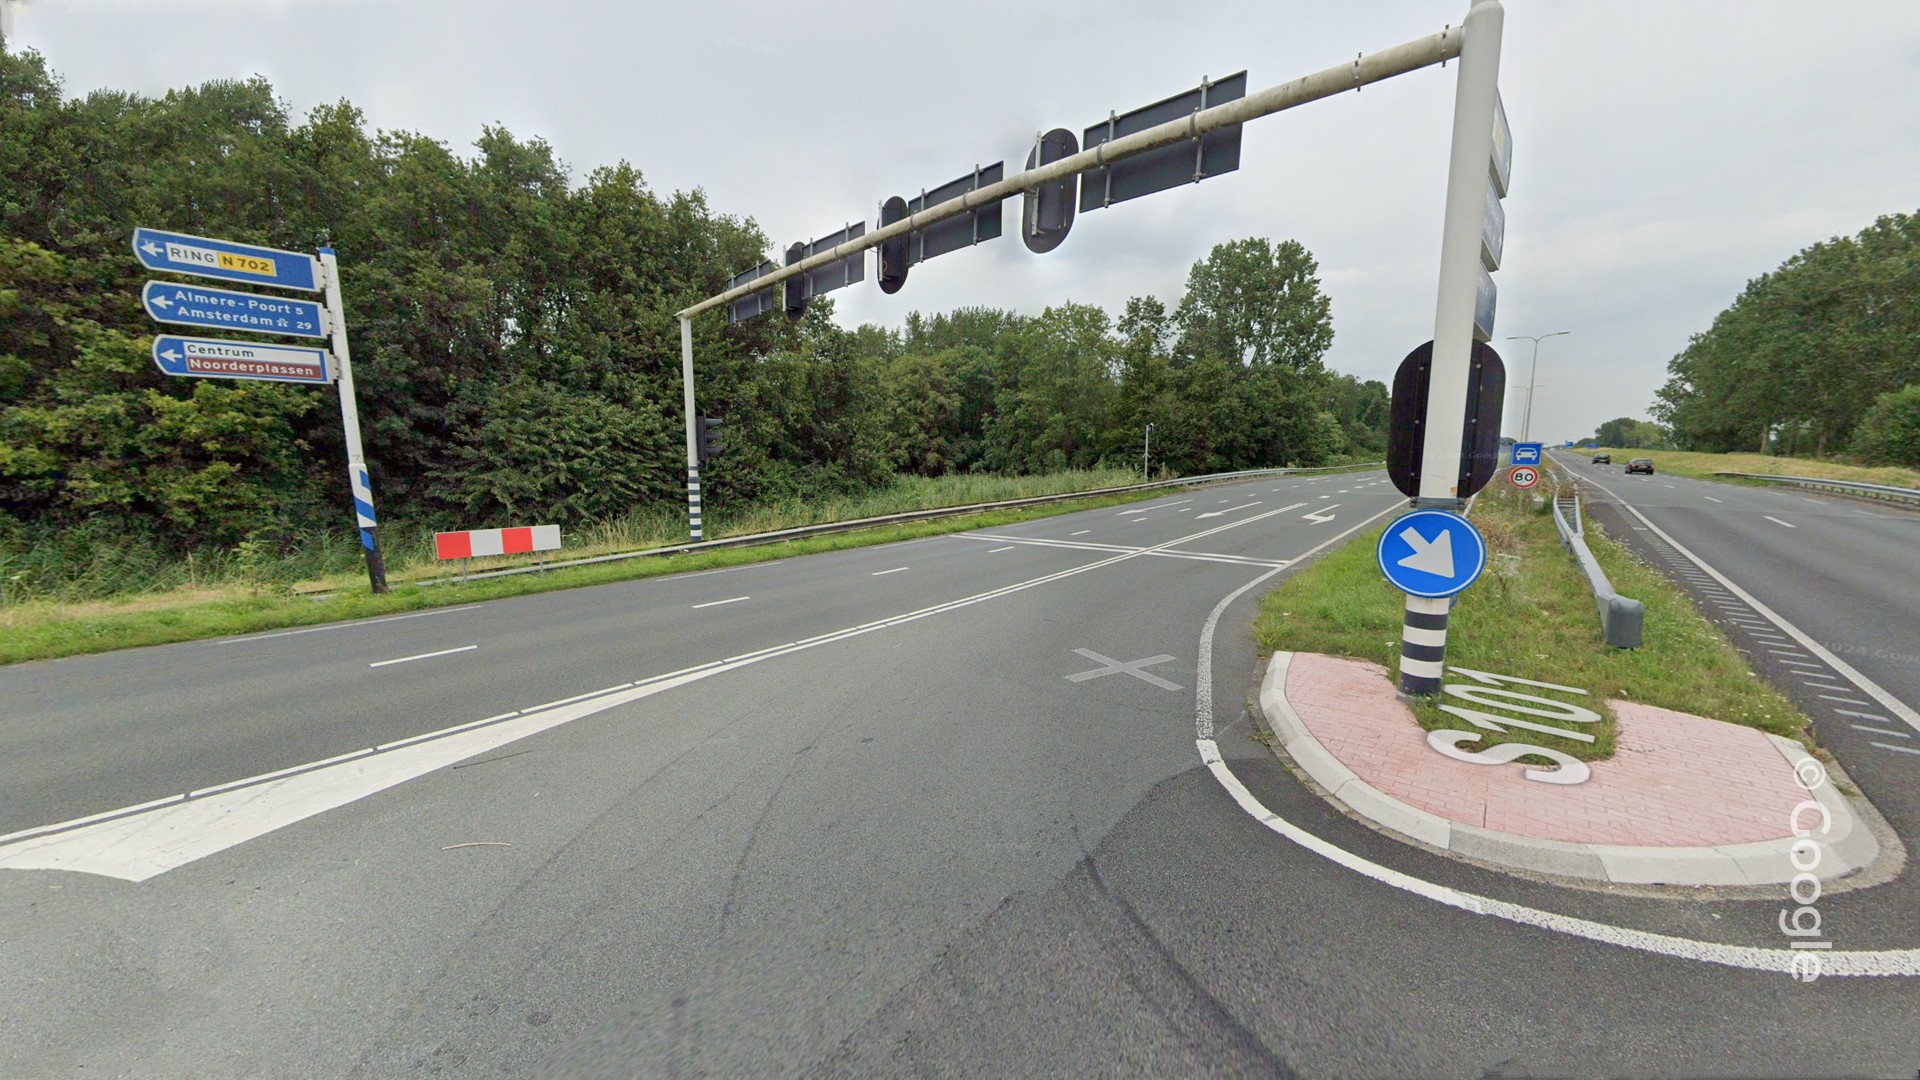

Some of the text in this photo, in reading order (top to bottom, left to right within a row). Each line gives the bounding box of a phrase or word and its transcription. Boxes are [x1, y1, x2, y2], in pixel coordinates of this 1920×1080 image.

[170, 247, 214, 263] RING
[175, 290, 304, 315] Almere-Poort 5
[177, 306, 312, 330] Amsterdam 29
[187, 345, 254, 357] Centrum
[189, 358, 314, 376] Noorderplassen
[1515, 473, 1534, 481] 80
